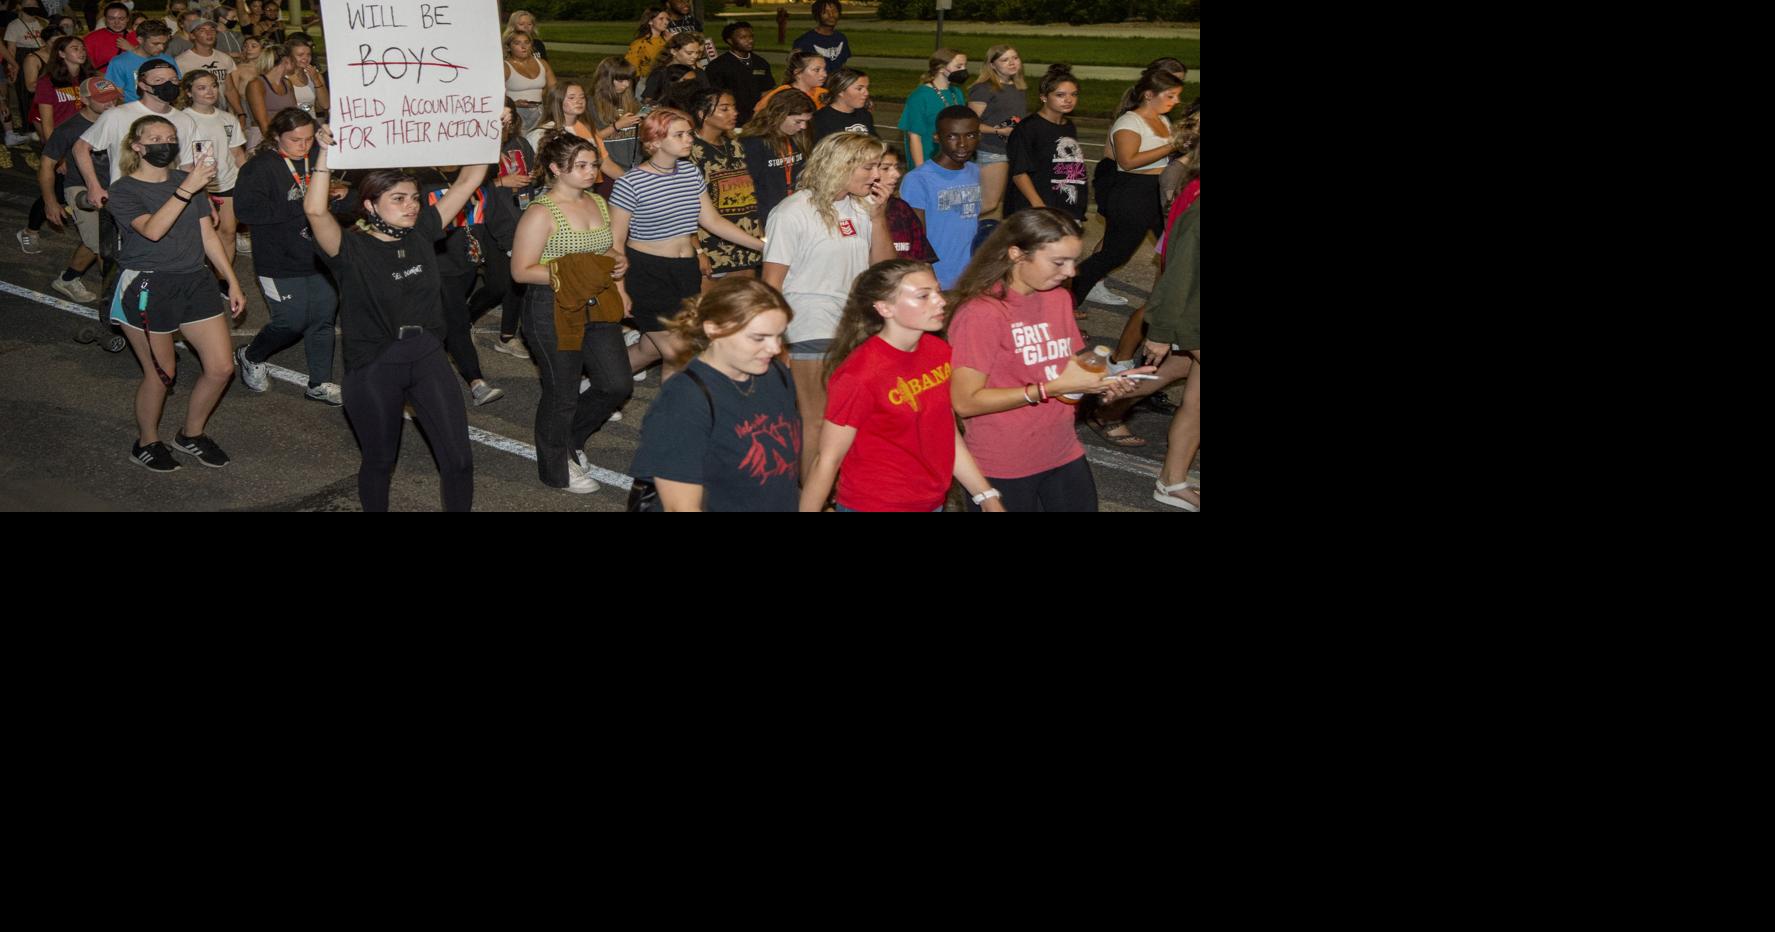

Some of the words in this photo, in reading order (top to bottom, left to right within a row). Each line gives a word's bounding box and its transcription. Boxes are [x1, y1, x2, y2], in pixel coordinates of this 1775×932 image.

[346, 2, 408, 30] WILL
[420, 4, 452, 29] BE
[359, 44, 459, 87] BOYS
[339, 96, 386, 123] HELD
[402, 94, 493, 117] ACCOUNTABLE
[339, 125, 376, 152] FOR
[381, 119, 431, 145] THEIR
[437, 119, 500, 142] ACTIONS
[768, 159, 784, 168] STOP
[1011, 322, 1050, 349] GRIT
[1044, 365, 1060, 381] N
